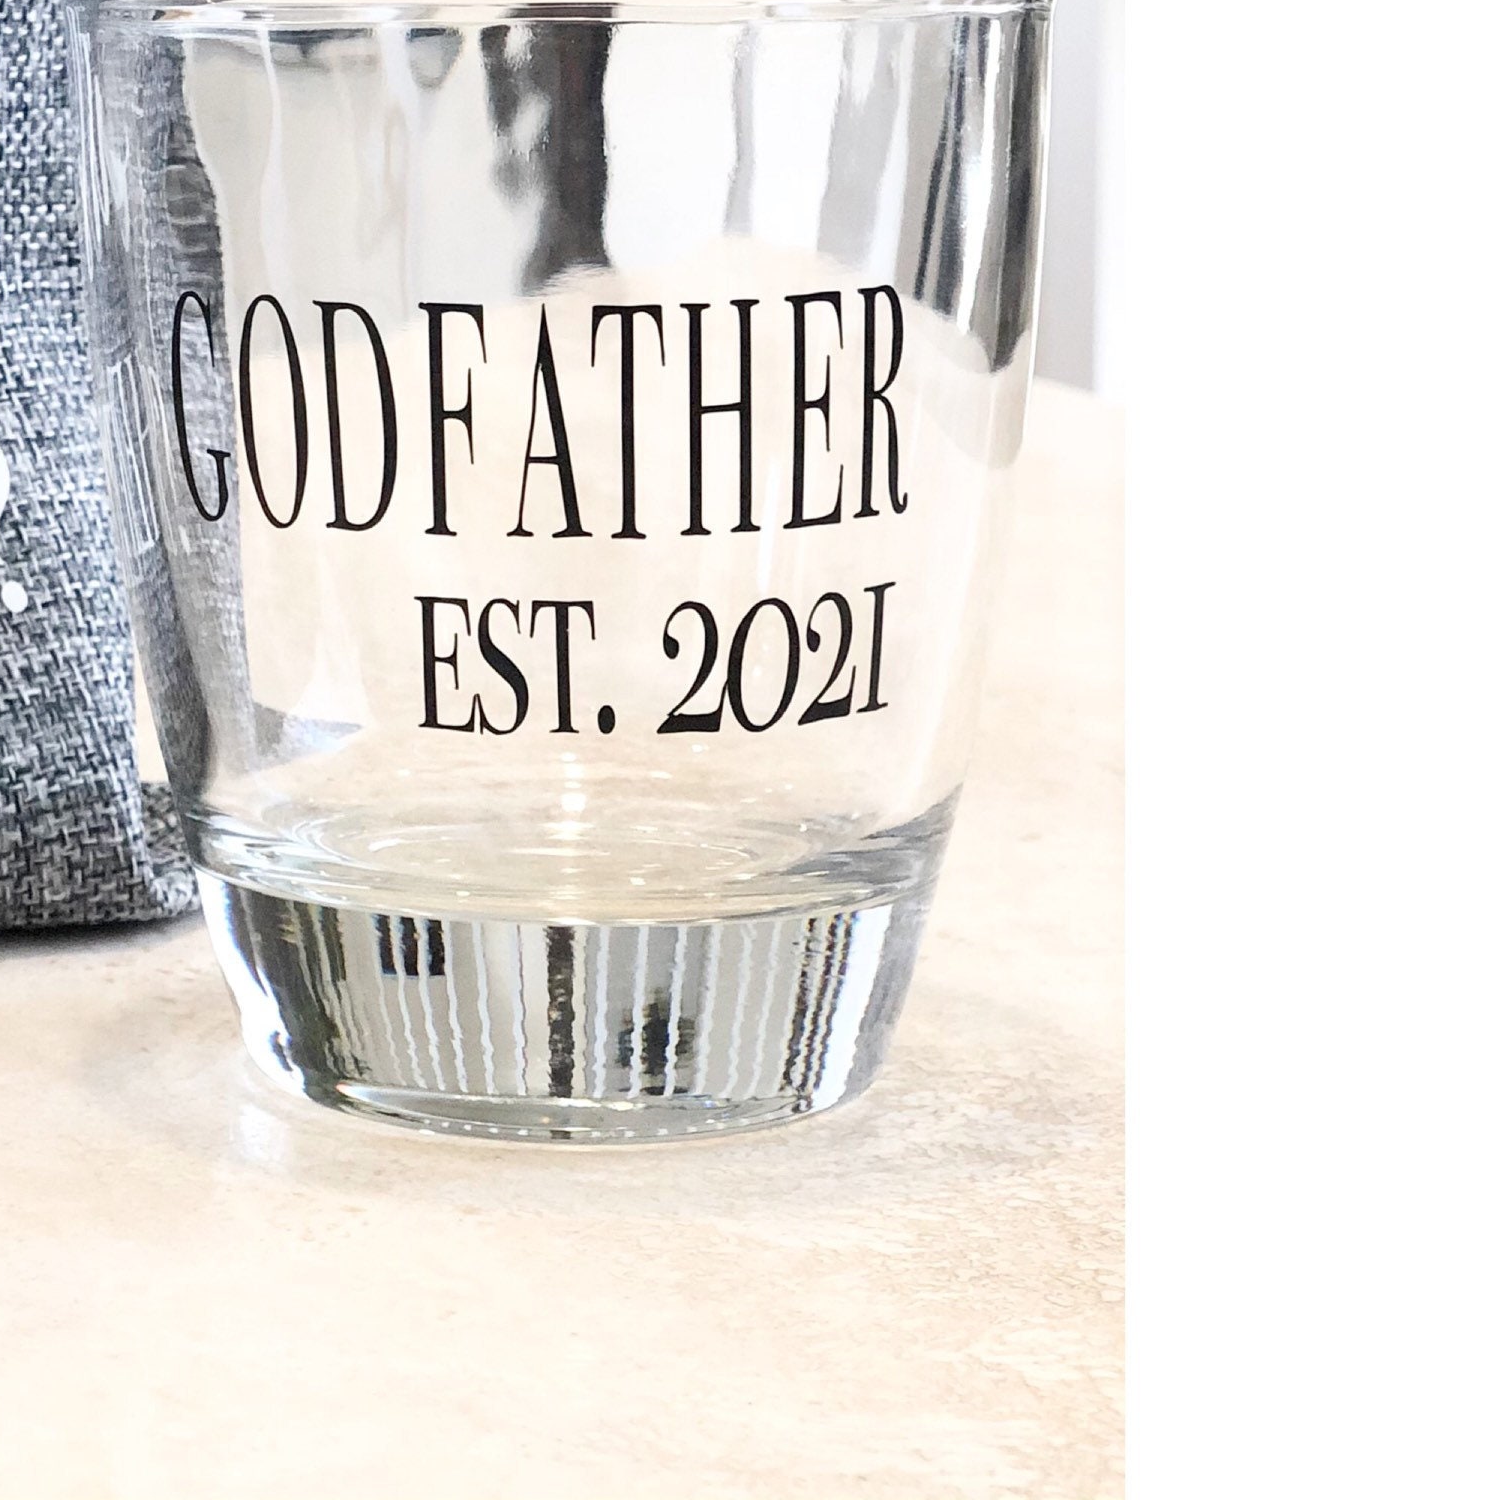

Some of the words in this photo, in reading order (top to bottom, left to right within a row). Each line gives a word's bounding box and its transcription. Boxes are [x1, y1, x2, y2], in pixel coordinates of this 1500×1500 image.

[171, 284, 910, 540] GODFATHER
[413, 594, 617, 736] EST.
[656, 580, 897, 735] 2021
